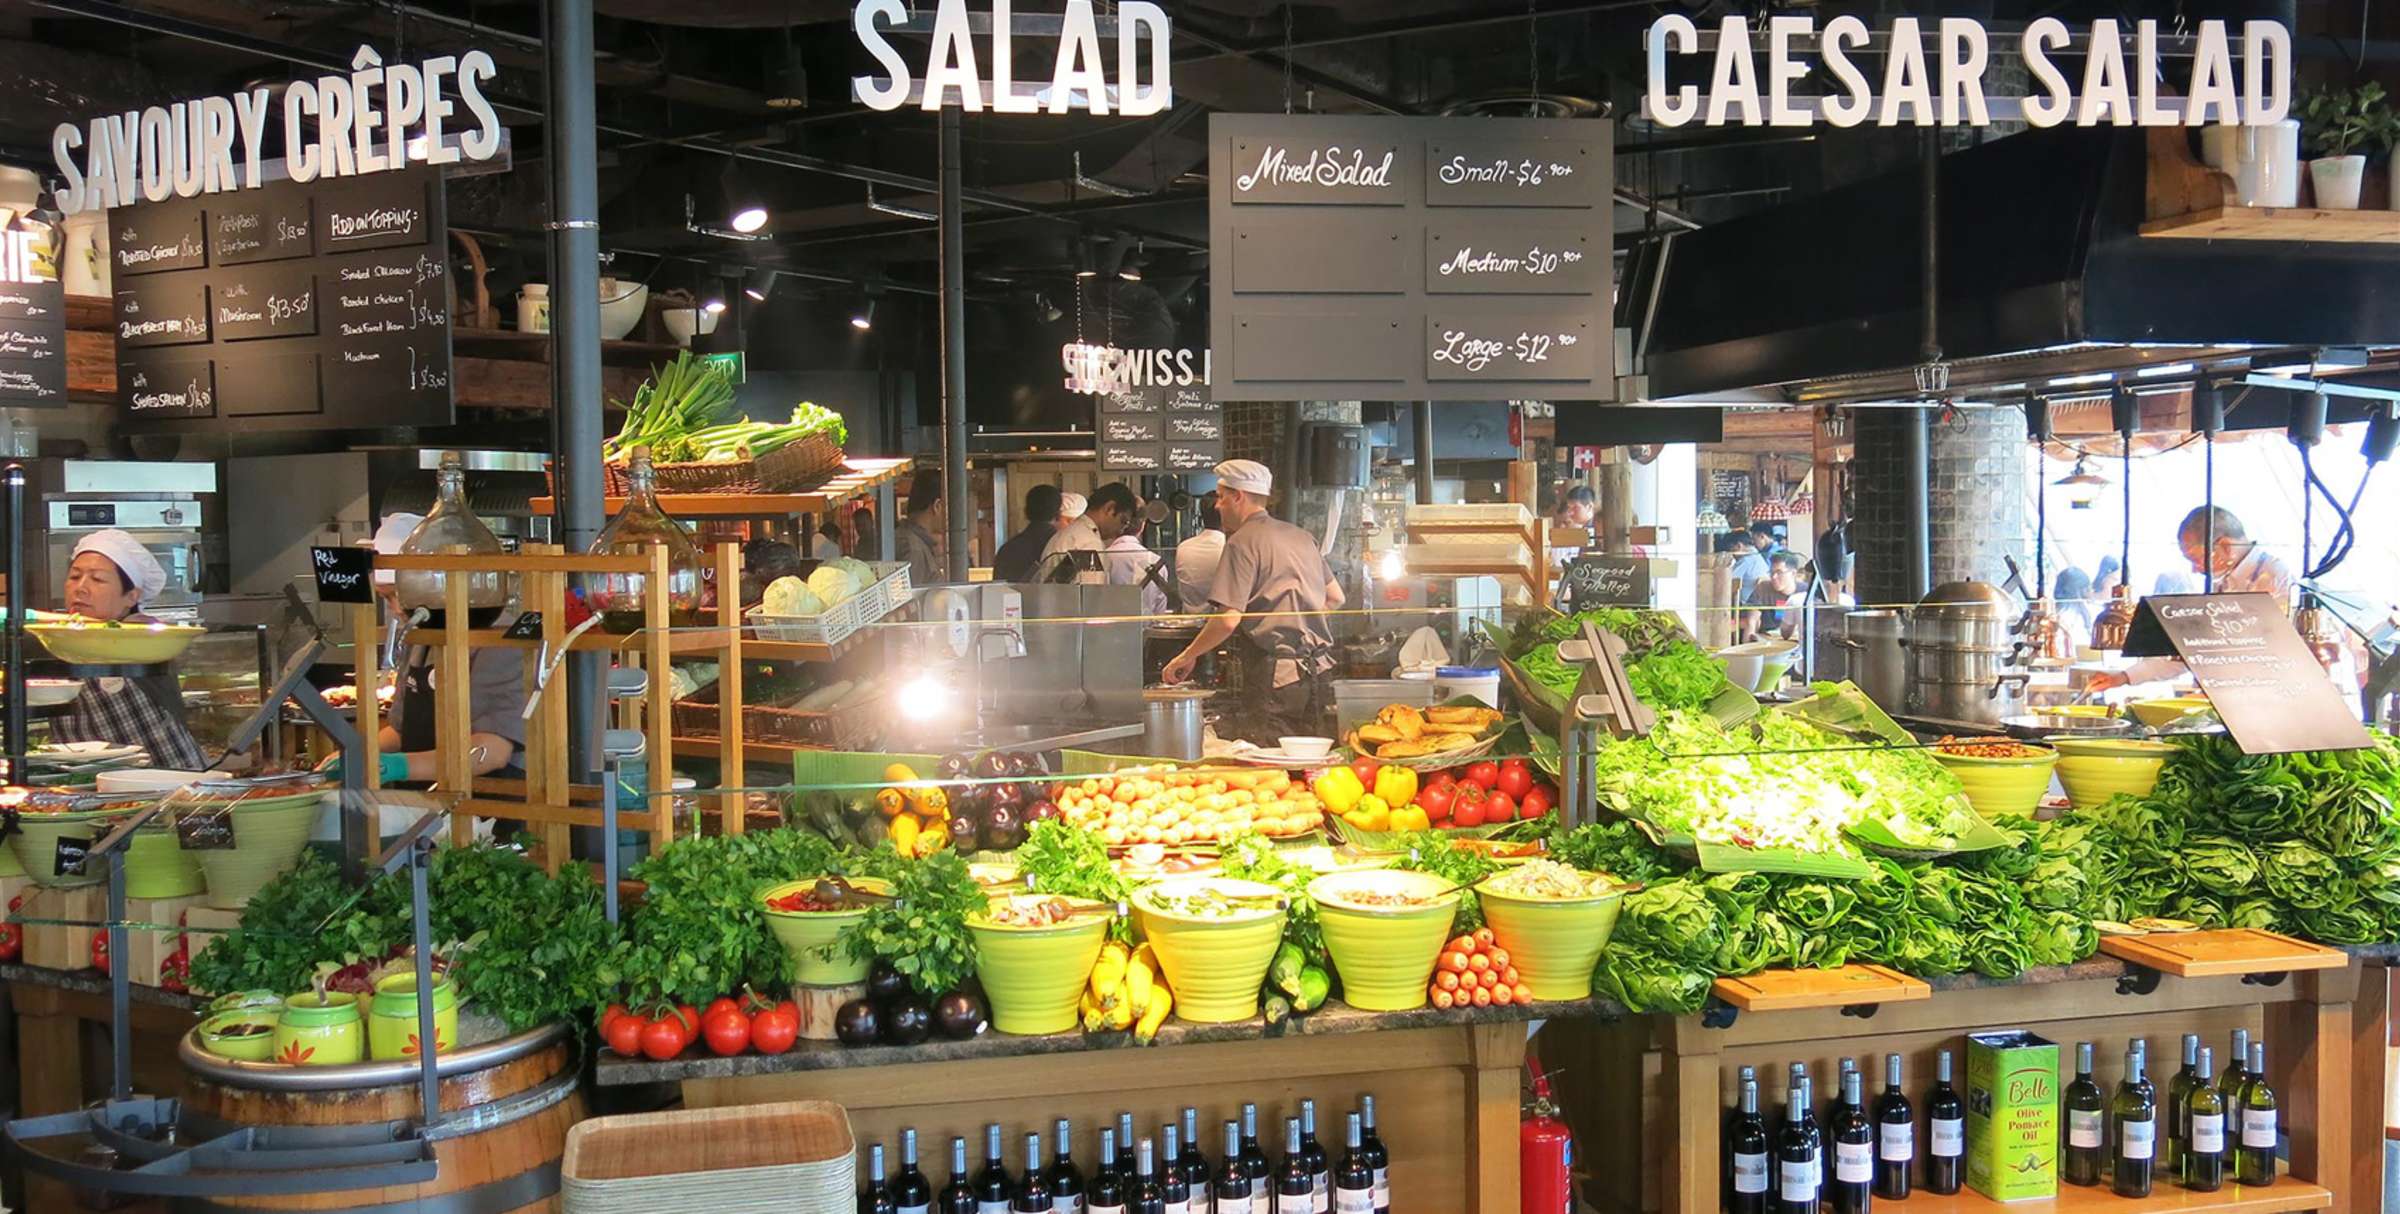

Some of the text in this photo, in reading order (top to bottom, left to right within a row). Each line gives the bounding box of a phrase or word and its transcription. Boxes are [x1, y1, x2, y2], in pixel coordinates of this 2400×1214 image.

[854, 0, 1170, 116] SALAD
[1646, 14, 2293, 127] CAESAR SALAD
[53, 44, 500, 215] SAVOURY CRÊPES
[1237, 145, 1393, 191] Mixed Salad
[314, 550, 339, 567] Red
[2160, 600, 2244, 620] Caesar Salad
[2016, 1108, 2043, 1119] Olive
[2008, 1119, 2051, 1131] Pomace
[2022, 1130, 2038, 1142] Oil
